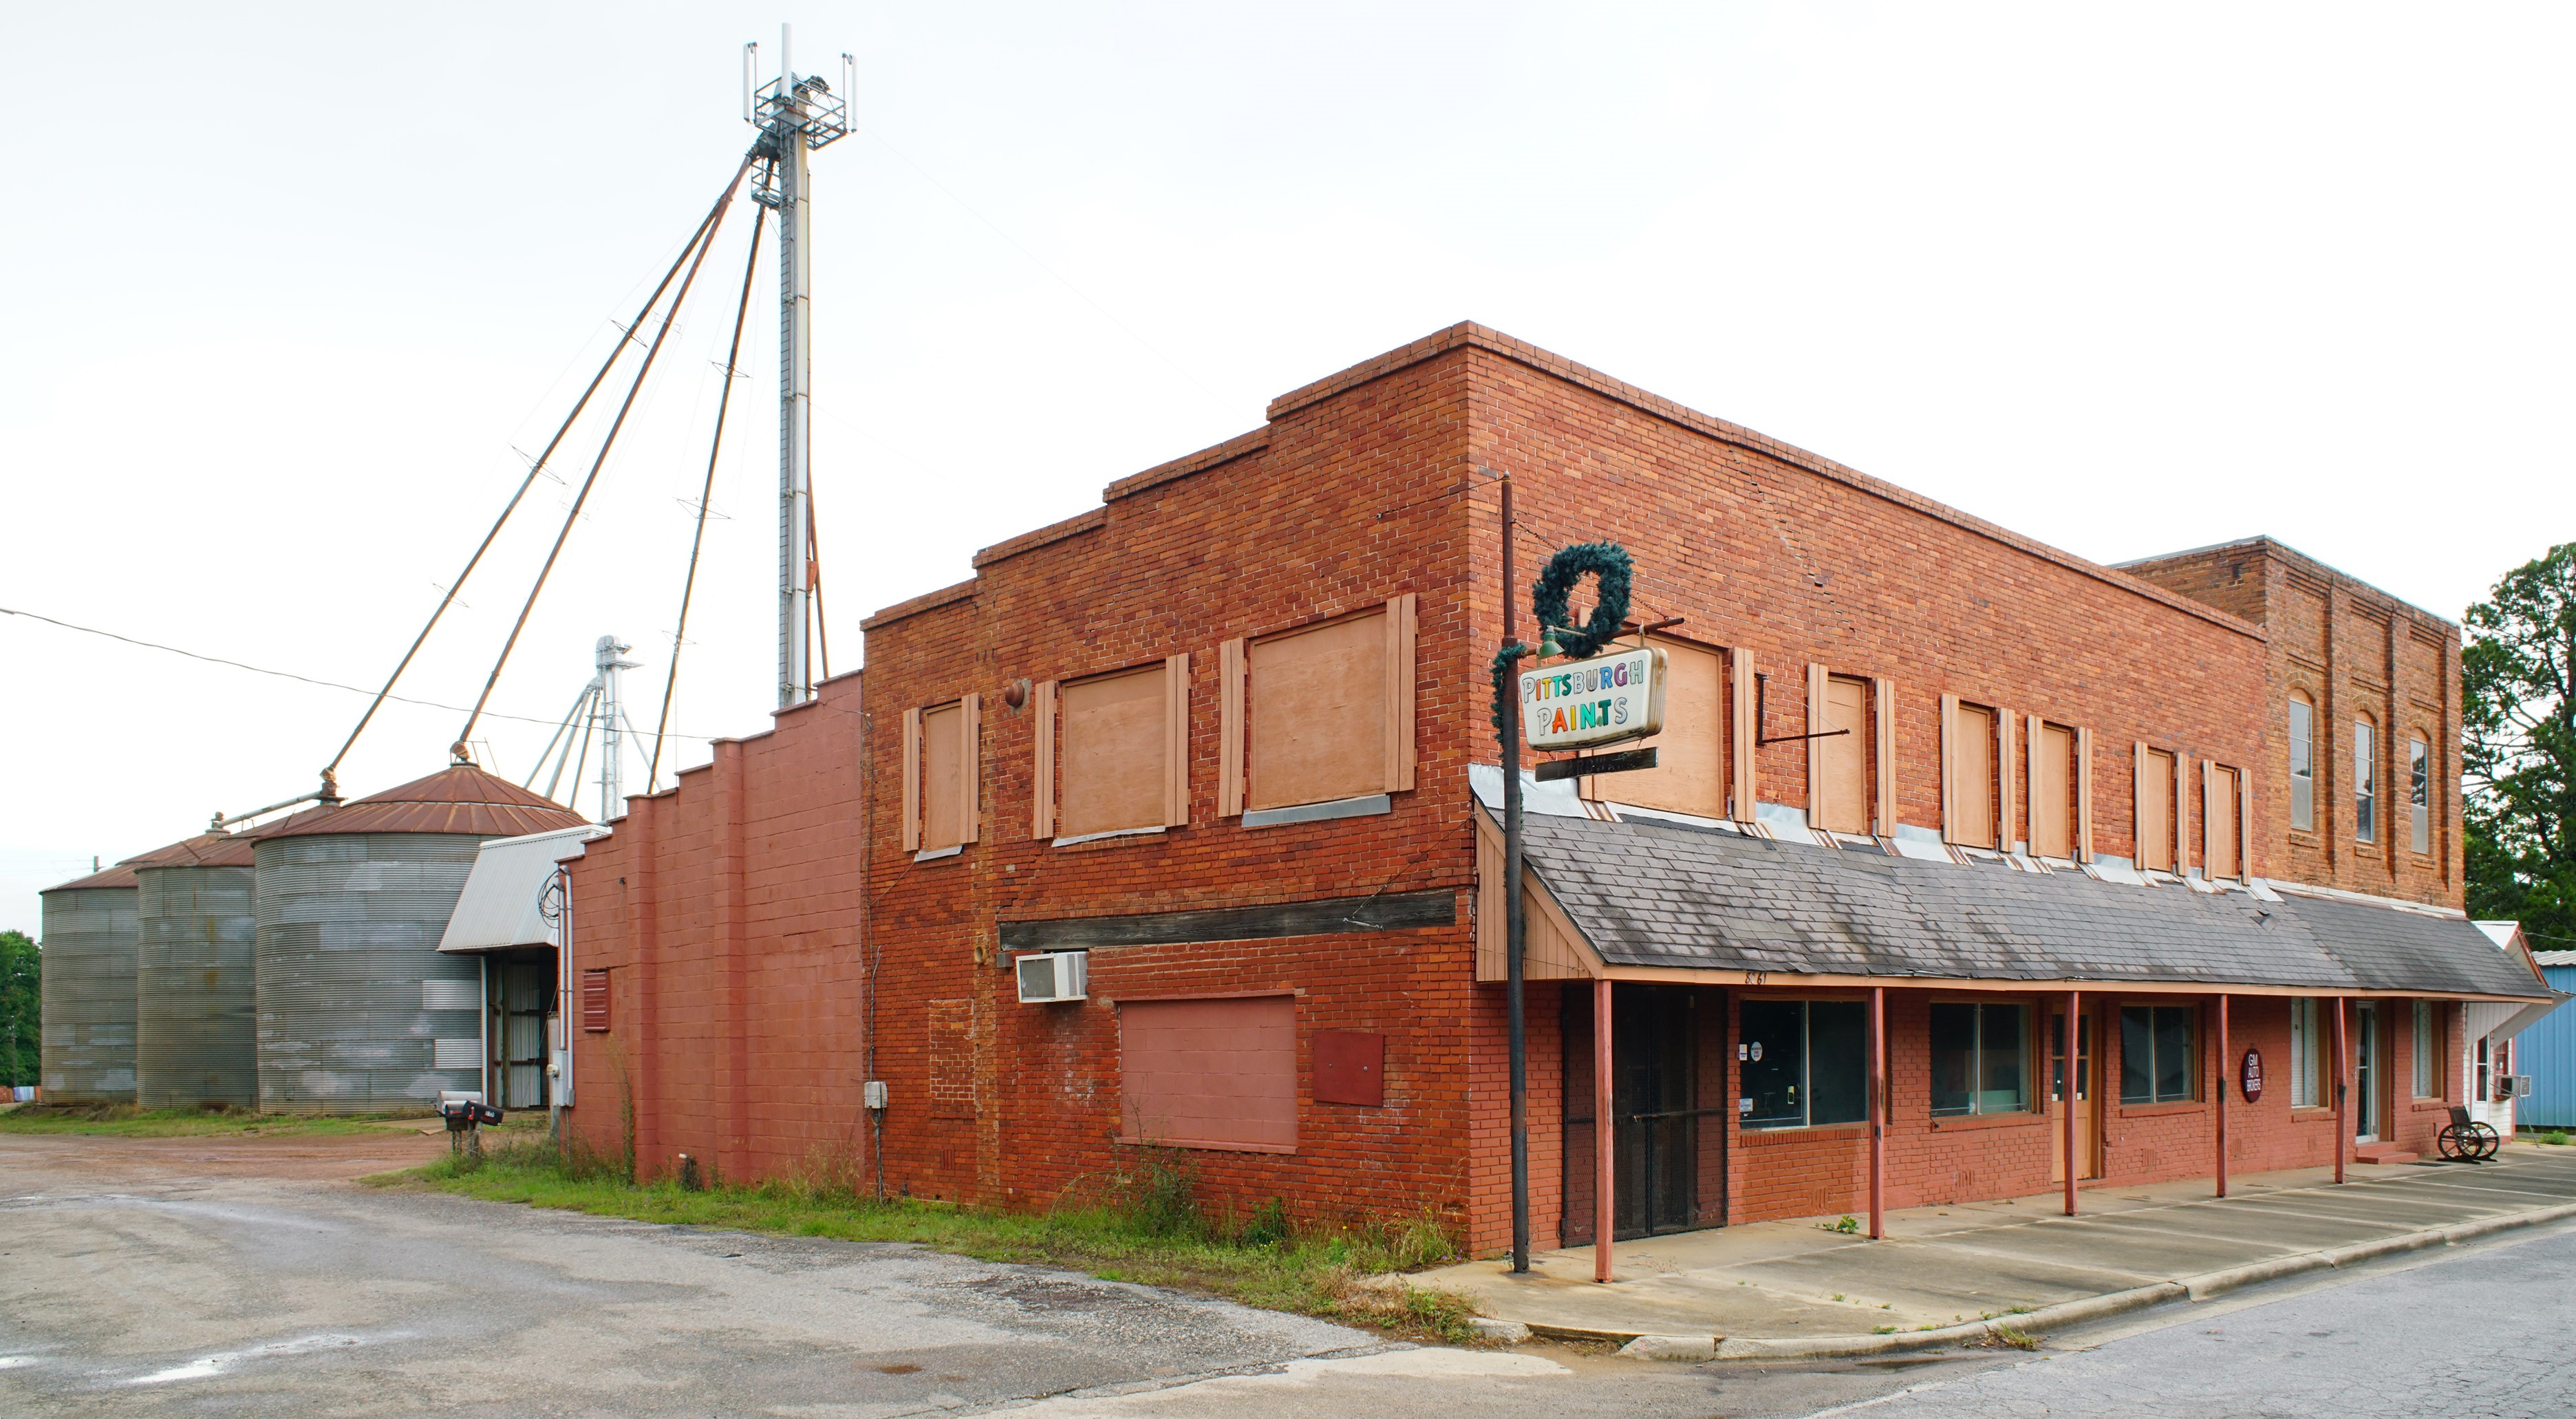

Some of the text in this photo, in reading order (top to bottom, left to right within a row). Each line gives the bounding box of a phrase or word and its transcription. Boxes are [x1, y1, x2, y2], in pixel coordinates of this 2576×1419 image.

[1522, 660, 1644, 703] PITTSBURGH
[1537, 697, 1628, 736] PAINTS
[2248, 1054, 2258, 1066] GM
[2248, 1066, 2260, 1078] AUTO
[2246, 1078, 2261, 1092] BROKERS
